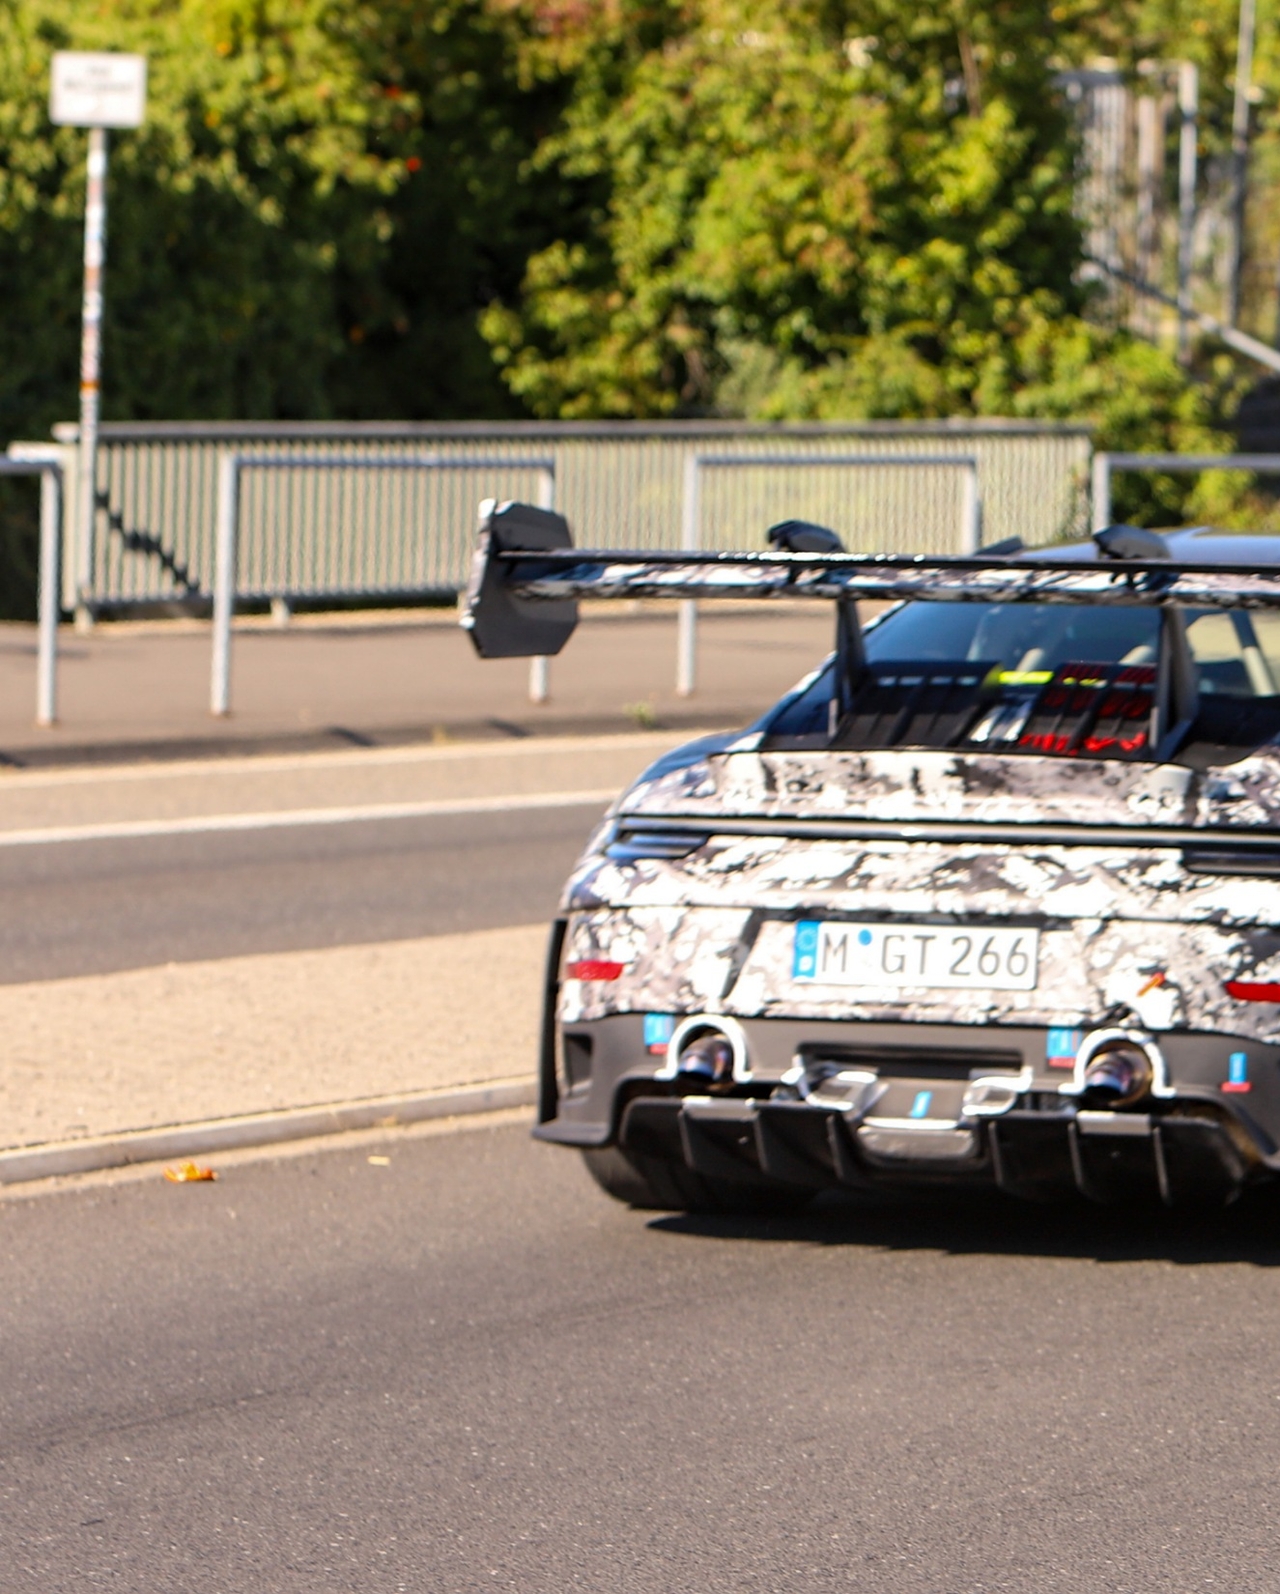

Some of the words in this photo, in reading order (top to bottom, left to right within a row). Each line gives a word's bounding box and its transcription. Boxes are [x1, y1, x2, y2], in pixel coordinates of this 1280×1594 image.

[822, 932, 848, 973] M
[881, 934, 937, 975] GT
[949, 935, 1029, 977] 266
